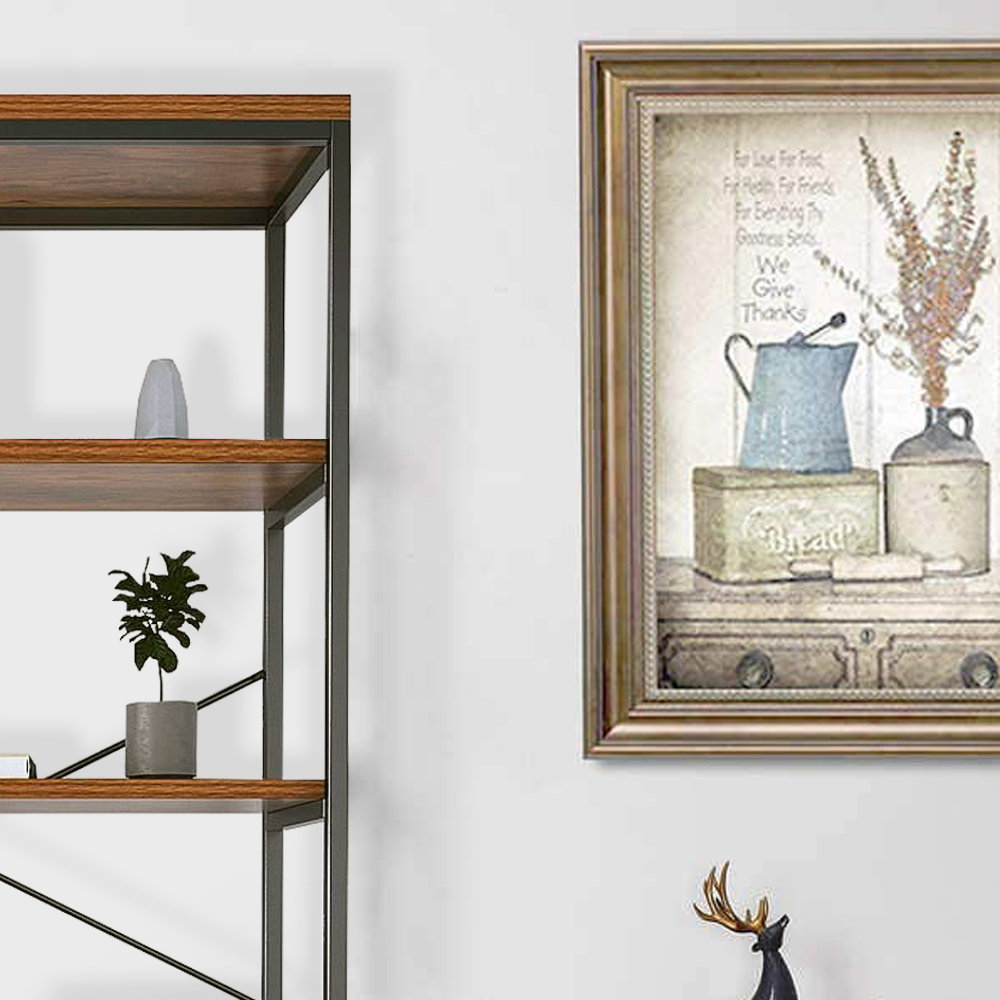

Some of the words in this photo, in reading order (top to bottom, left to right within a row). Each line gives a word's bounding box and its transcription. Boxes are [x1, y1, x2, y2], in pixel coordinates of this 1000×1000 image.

[756, 255, 790, 275] We
[752, 278, 795, 299] Give
[741, 302, 807, 324] Thanks
[761, 523, 847, 553] Bread
